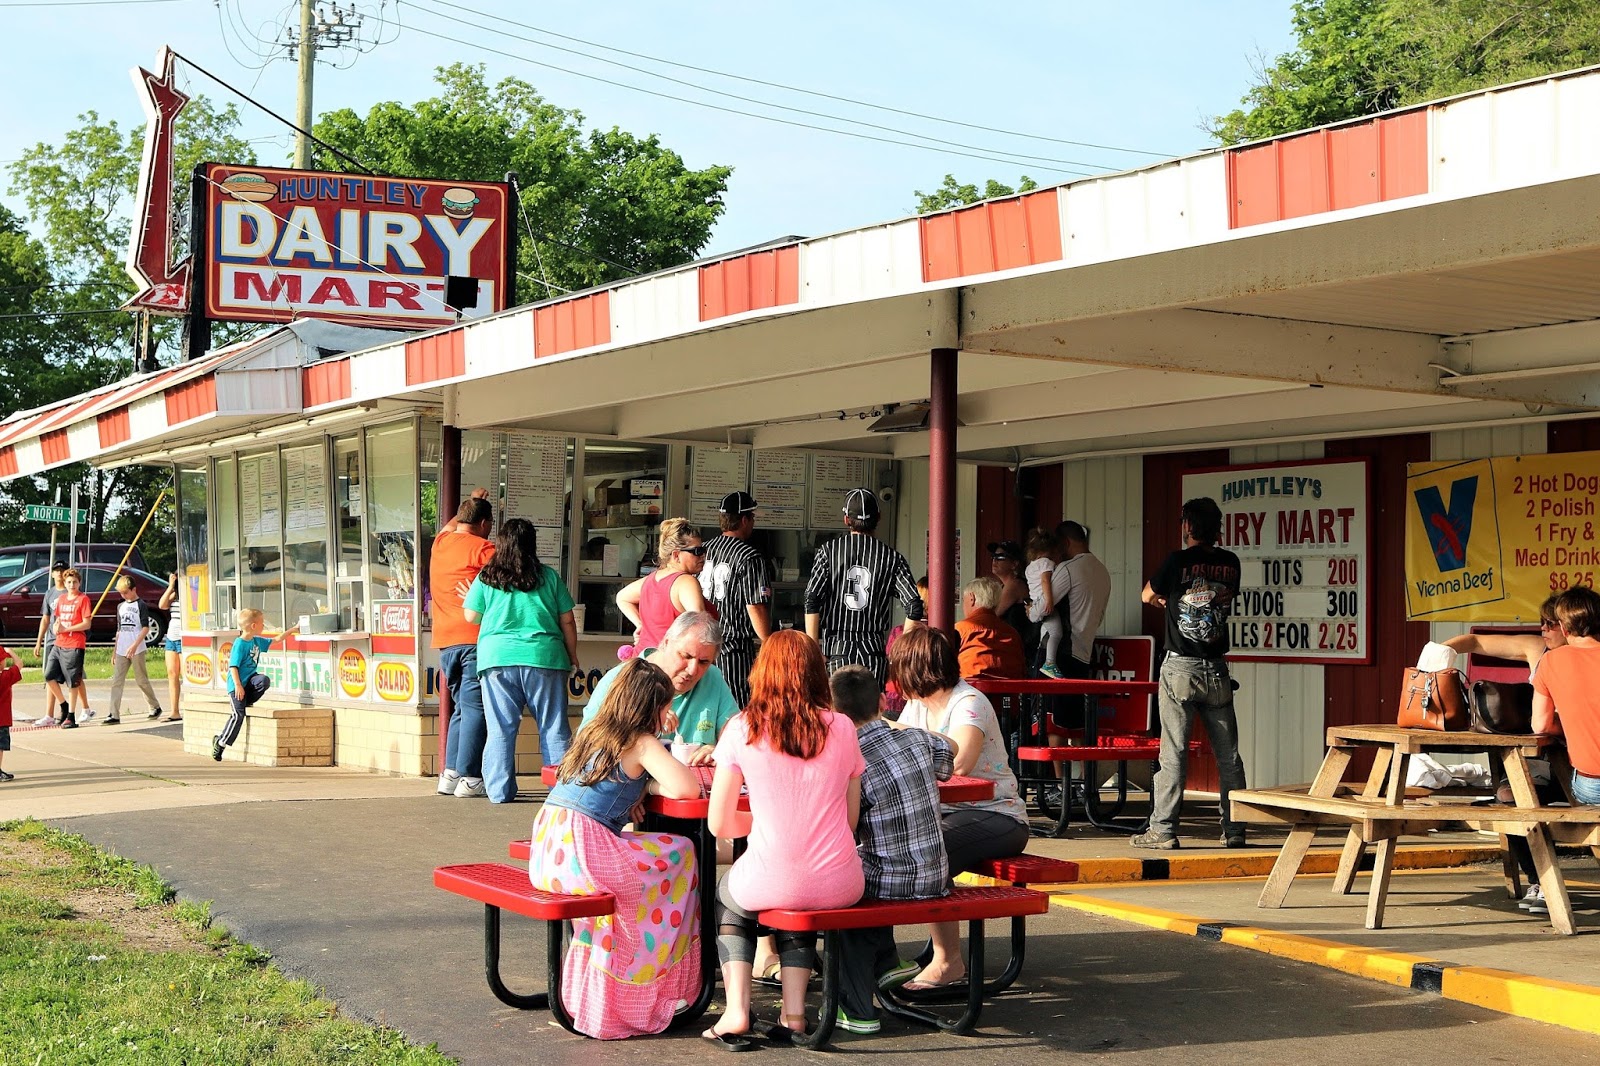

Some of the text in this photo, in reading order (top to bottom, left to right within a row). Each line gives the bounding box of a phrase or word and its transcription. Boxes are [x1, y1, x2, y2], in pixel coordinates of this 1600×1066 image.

[279, 178, 428, 207] HUNTLEY
[216, 200, 495, 278] DAIRY
[1222, 476, 1322, 502] HUNTLEY'S
[1513, 472, 1600, 495] 2 Hot Dog
[33, 506, 64, 521] NORTH
[1526, 497, 1595, 518] 2 Polish
[1277, 507, 1355, 545] MART
[1534, 521, 1595, 546] 1 Fry &
[1515, 547, 1549, 567] Med
[1262, 558, 1358, 586] TOTS 200
[1416, 567, 1494, 599] Vienna Beef
[843, 564, 872, 612] 3
[1326, 590, 1358, 617] 300
[1228, 622, 1259, 648] LES
[1318, 622, 1358, 650] 2.25
[186, 659, 211, 678] BURGERS
[220, 660, 229, 673] DO
[344, 655, 361, 667] DAILY
[378, 668, 410, 692] SALADS
